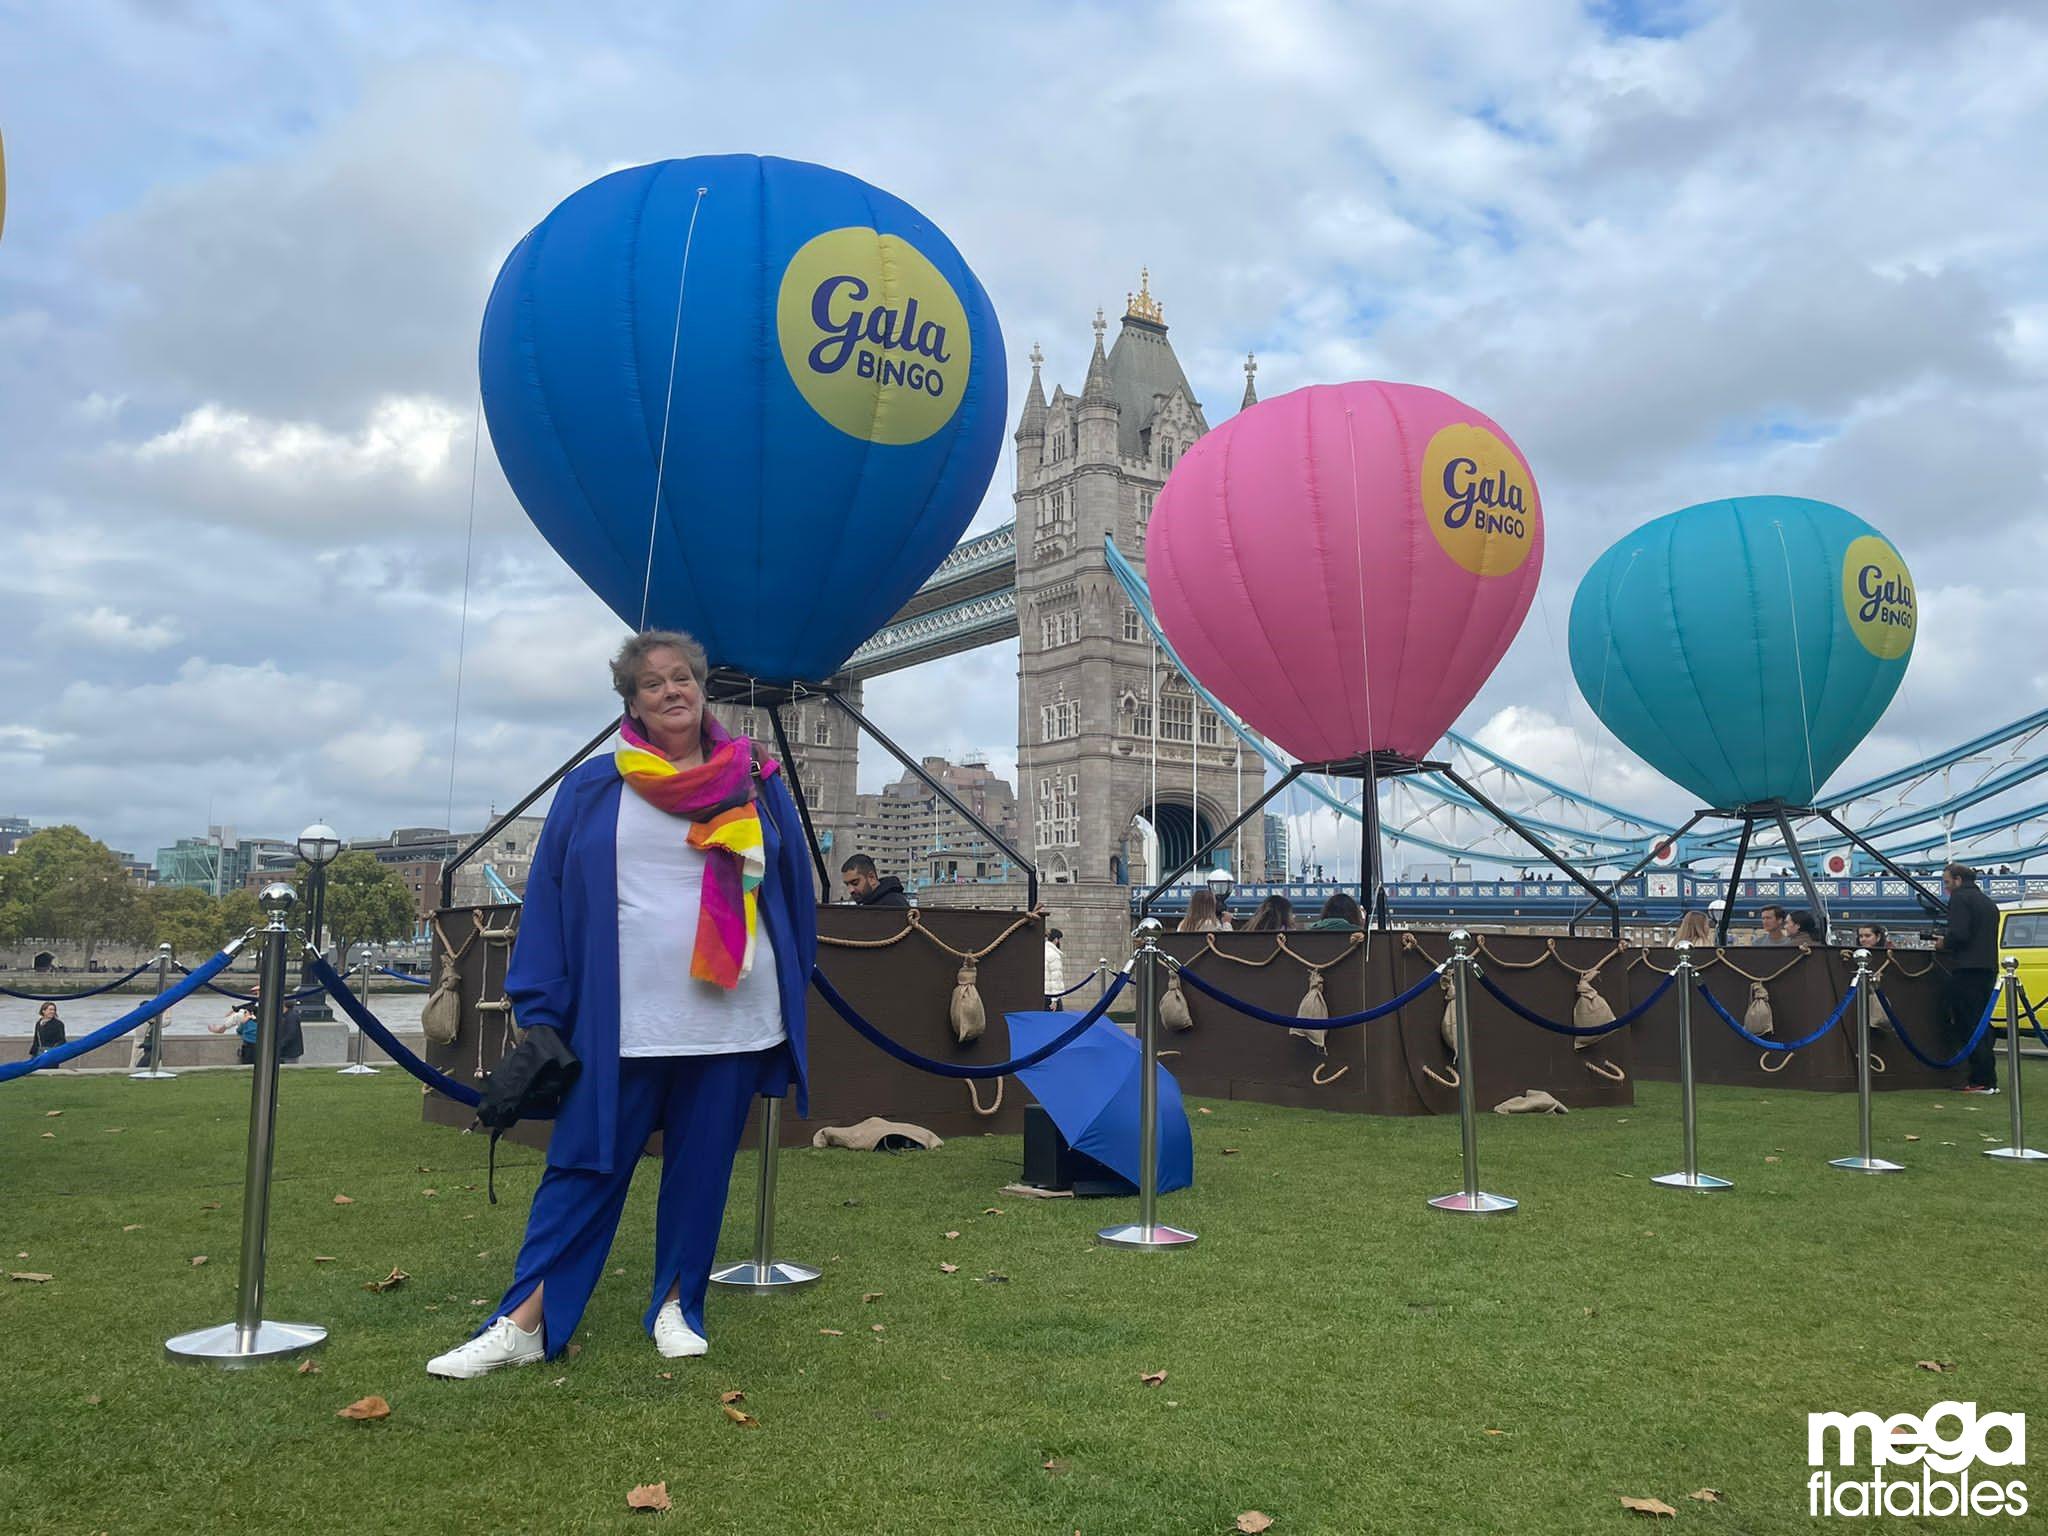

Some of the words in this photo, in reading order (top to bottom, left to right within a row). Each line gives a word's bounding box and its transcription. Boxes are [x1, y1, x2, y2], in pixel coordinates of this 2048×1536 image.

[808, 275, 951, 374] Gala
[857, 350, 944, 397] BINGO
[1443, 457, 1527, 529] Gala
[1475, 509, 1525, 539] BINGO
[1858, 565, 1913, 622] Gala
[1881, 607, 1913, 629] BNGO
